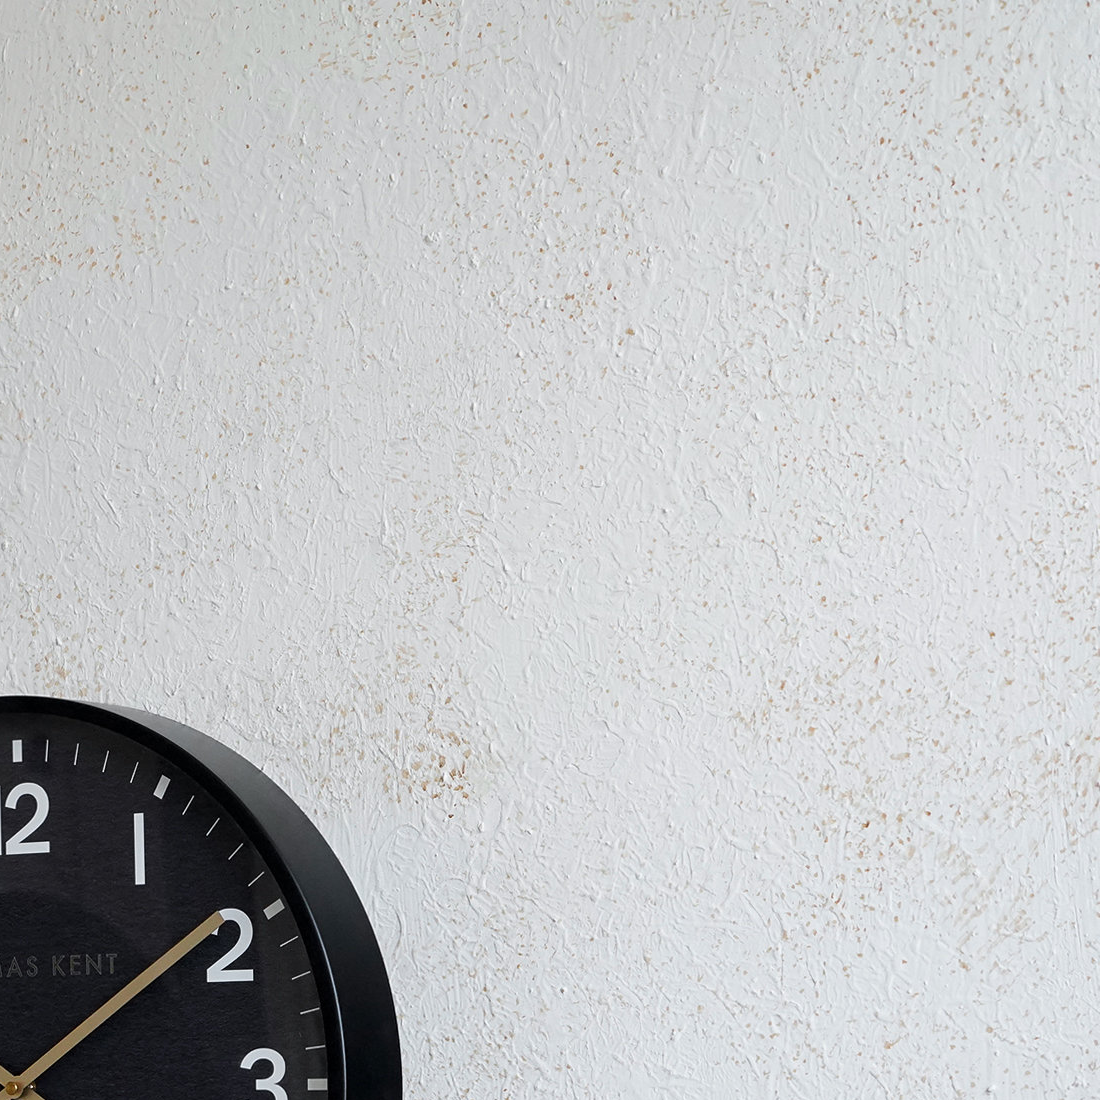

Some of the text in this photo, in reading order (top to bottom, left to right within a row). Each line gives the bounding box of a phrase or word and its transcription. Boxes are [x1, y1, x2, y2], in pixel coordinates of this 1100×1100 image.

[134, 813, 145, 885] 1
[52, 953, 118, 977] KENT
[207, 908, 253, 982] 2
